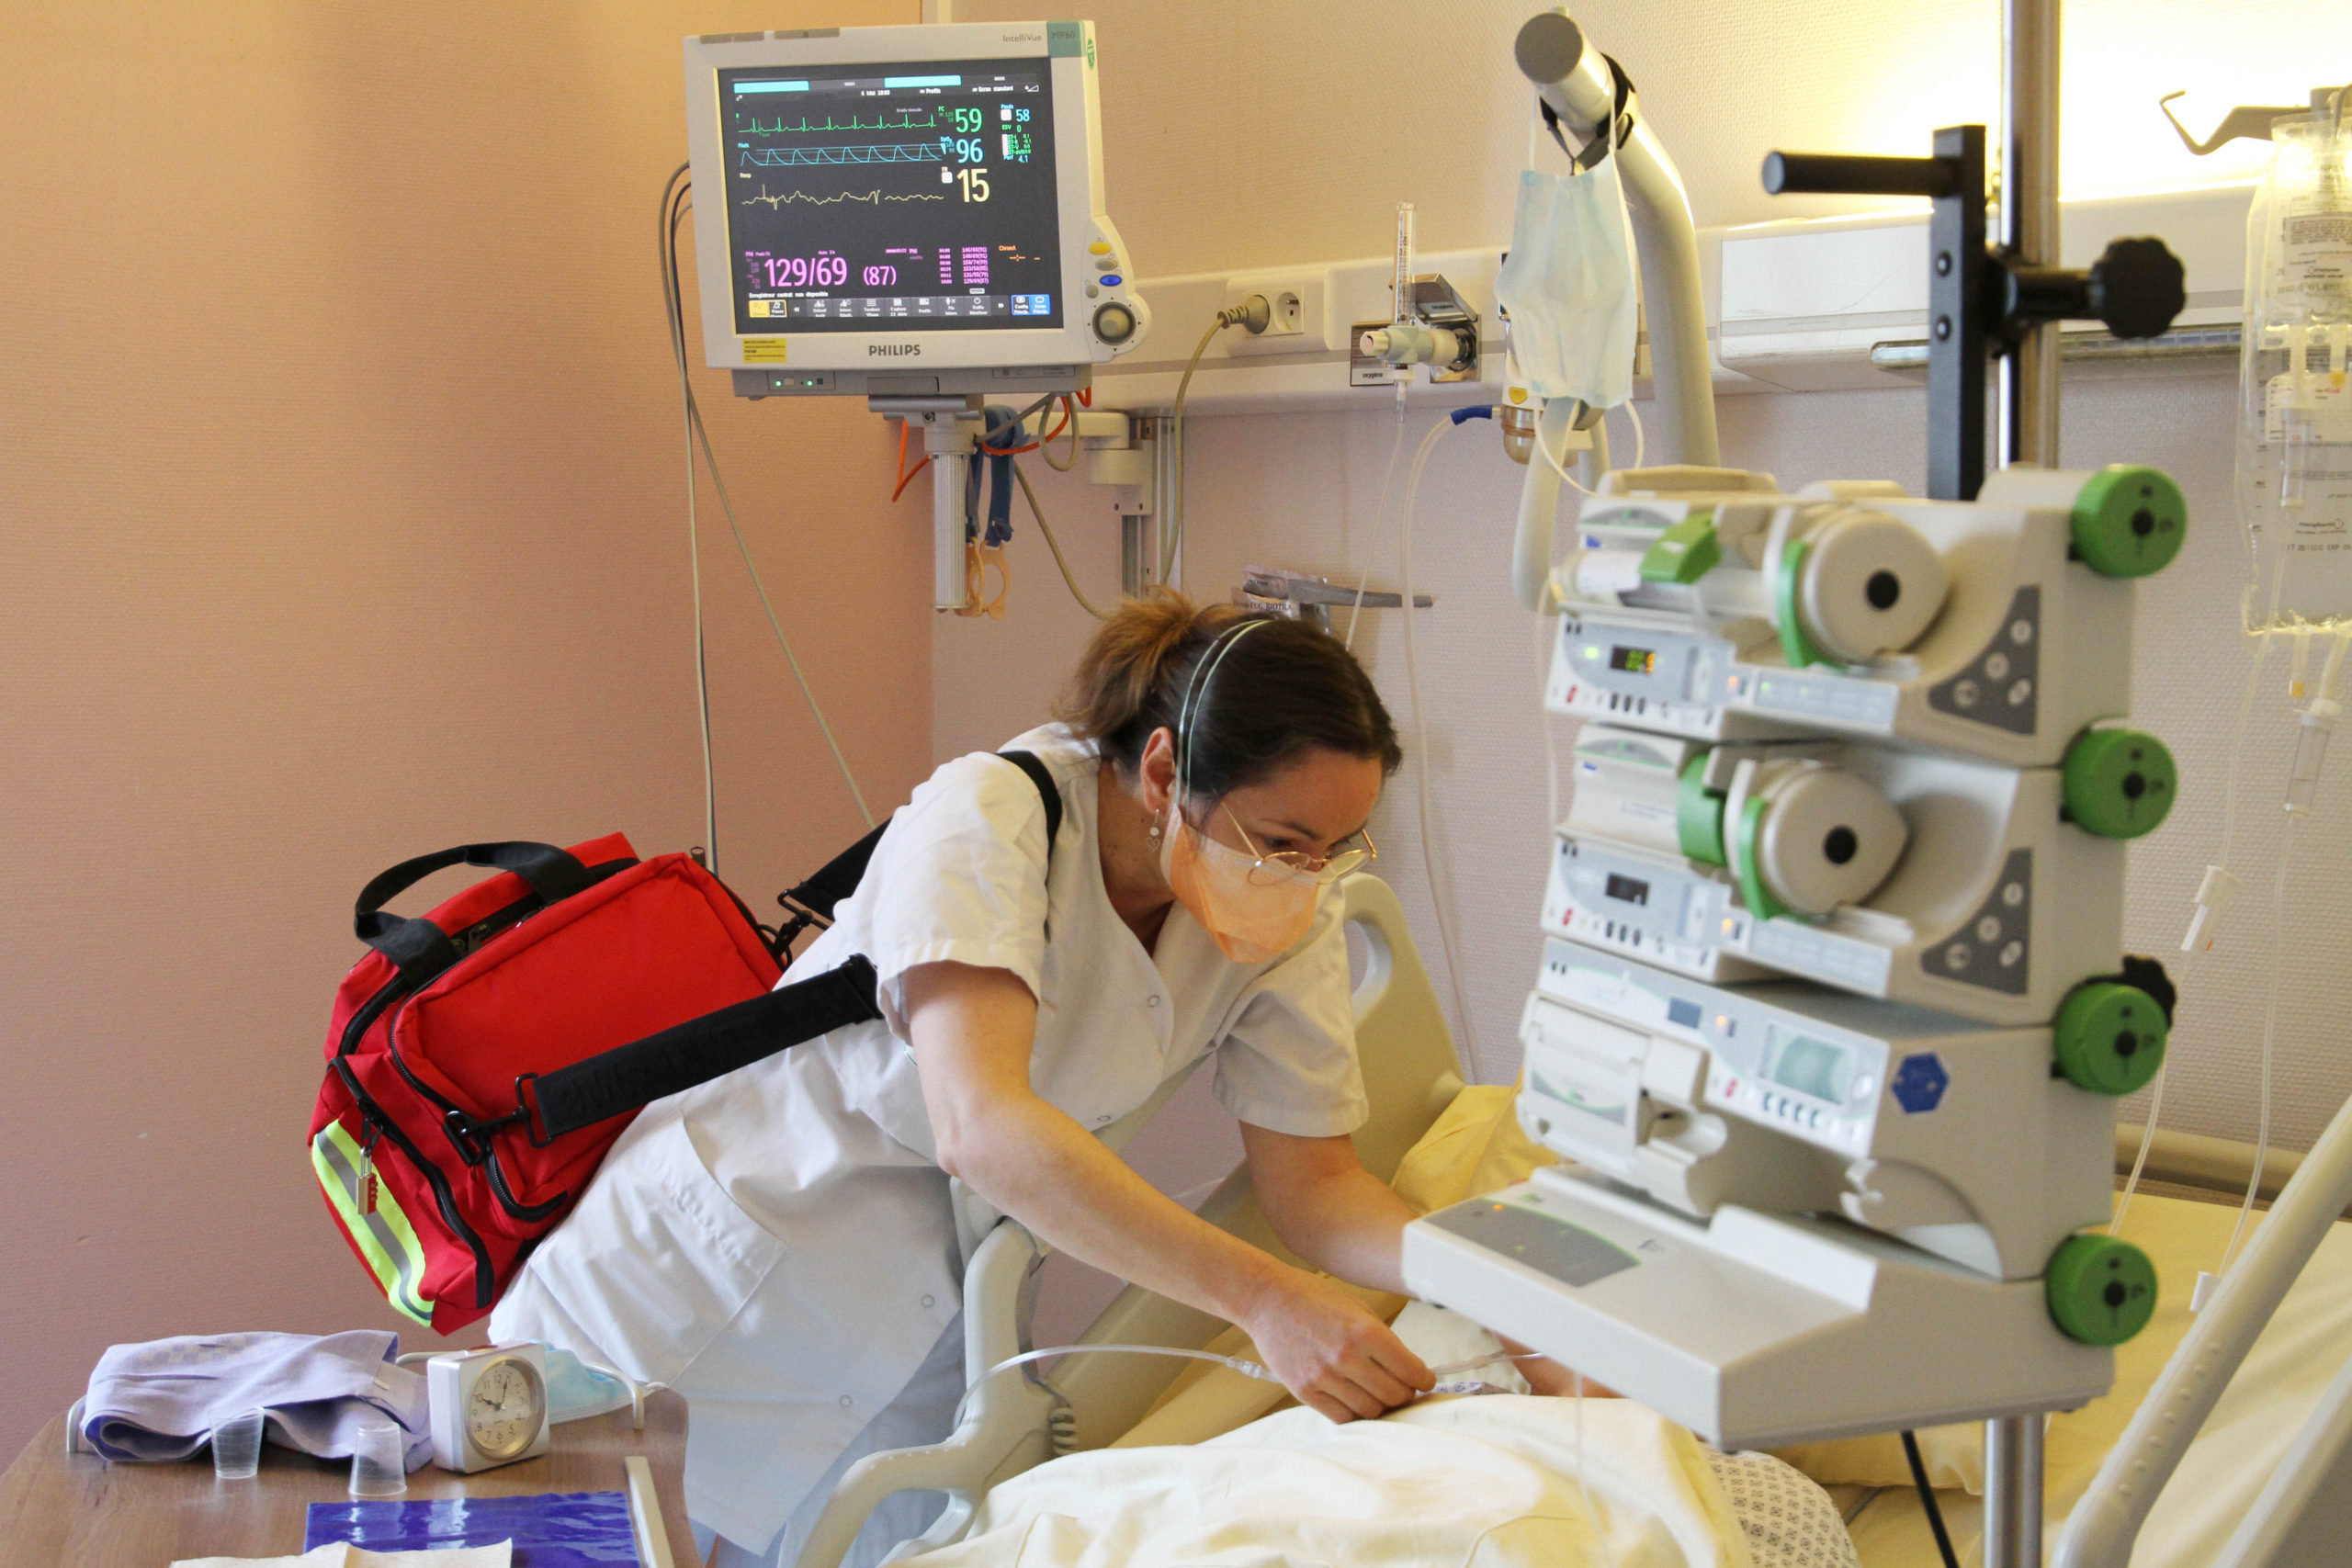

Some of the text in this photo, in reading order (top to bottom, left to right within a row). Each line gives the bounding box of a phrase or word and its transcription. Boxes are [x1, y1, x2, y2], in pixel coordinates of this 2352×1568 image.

[1002, 33, 1043, 42] IntelliVue
[955, 107, 983, 133] 59
[1015, 108, 1031, 122] 58
[956, 138, 984, 164] 96
[1017, 154, 1029, 164] 4.1
[956, 168, 989, 203] 15
[763, 257, 848, 288] 129/69
[863, 265, 898, 286] (87)
[868, 344, 922, 356] PHILIPS
[477, 1422, 483, 1432] 8
[497, 1431, 503, 1441] 6
